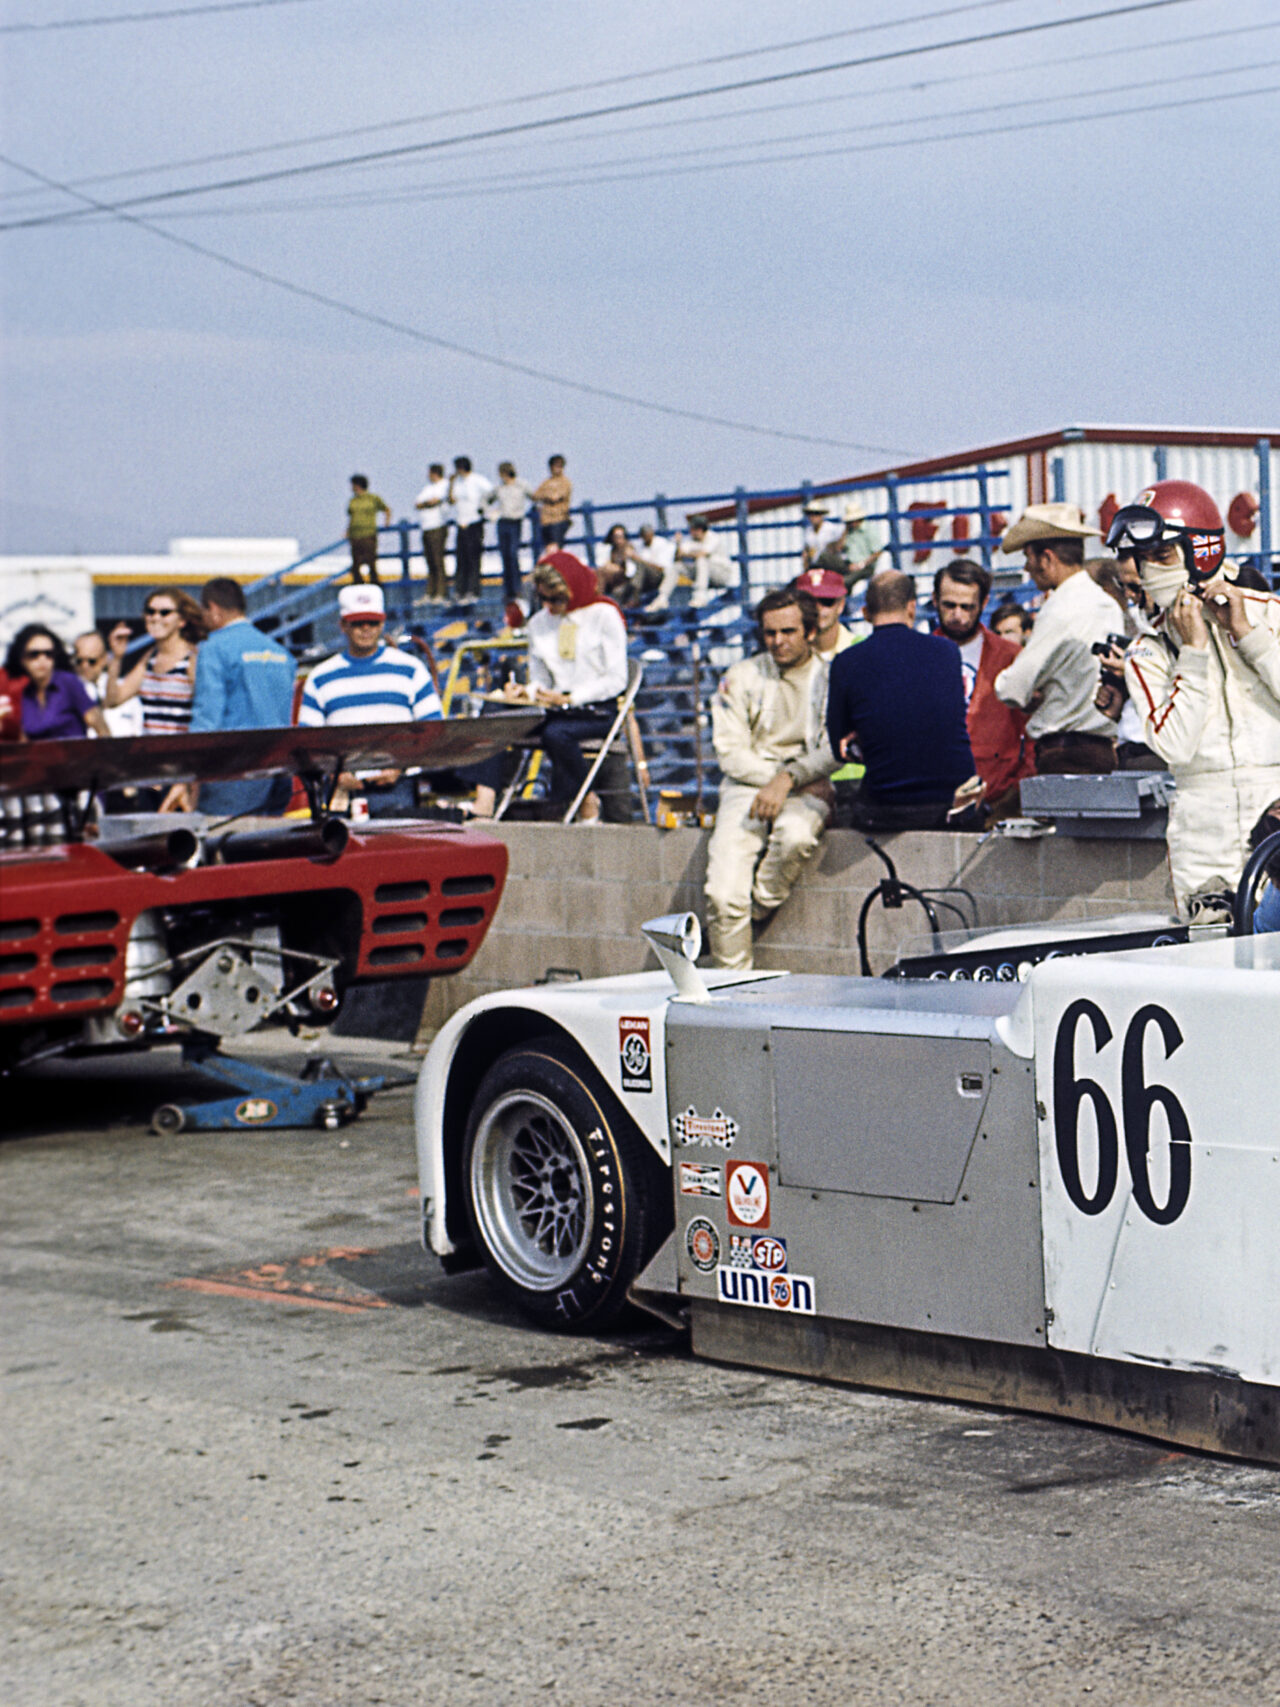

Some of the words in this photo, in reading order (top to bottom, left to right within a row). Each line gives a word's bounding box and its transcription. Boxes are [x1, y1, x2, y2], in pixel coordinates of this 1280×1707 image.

[1053, 998, 1193, 1226] 66
[756, 1241, 783, 1267] STP
[773, 1283, 789, 1300] 76
